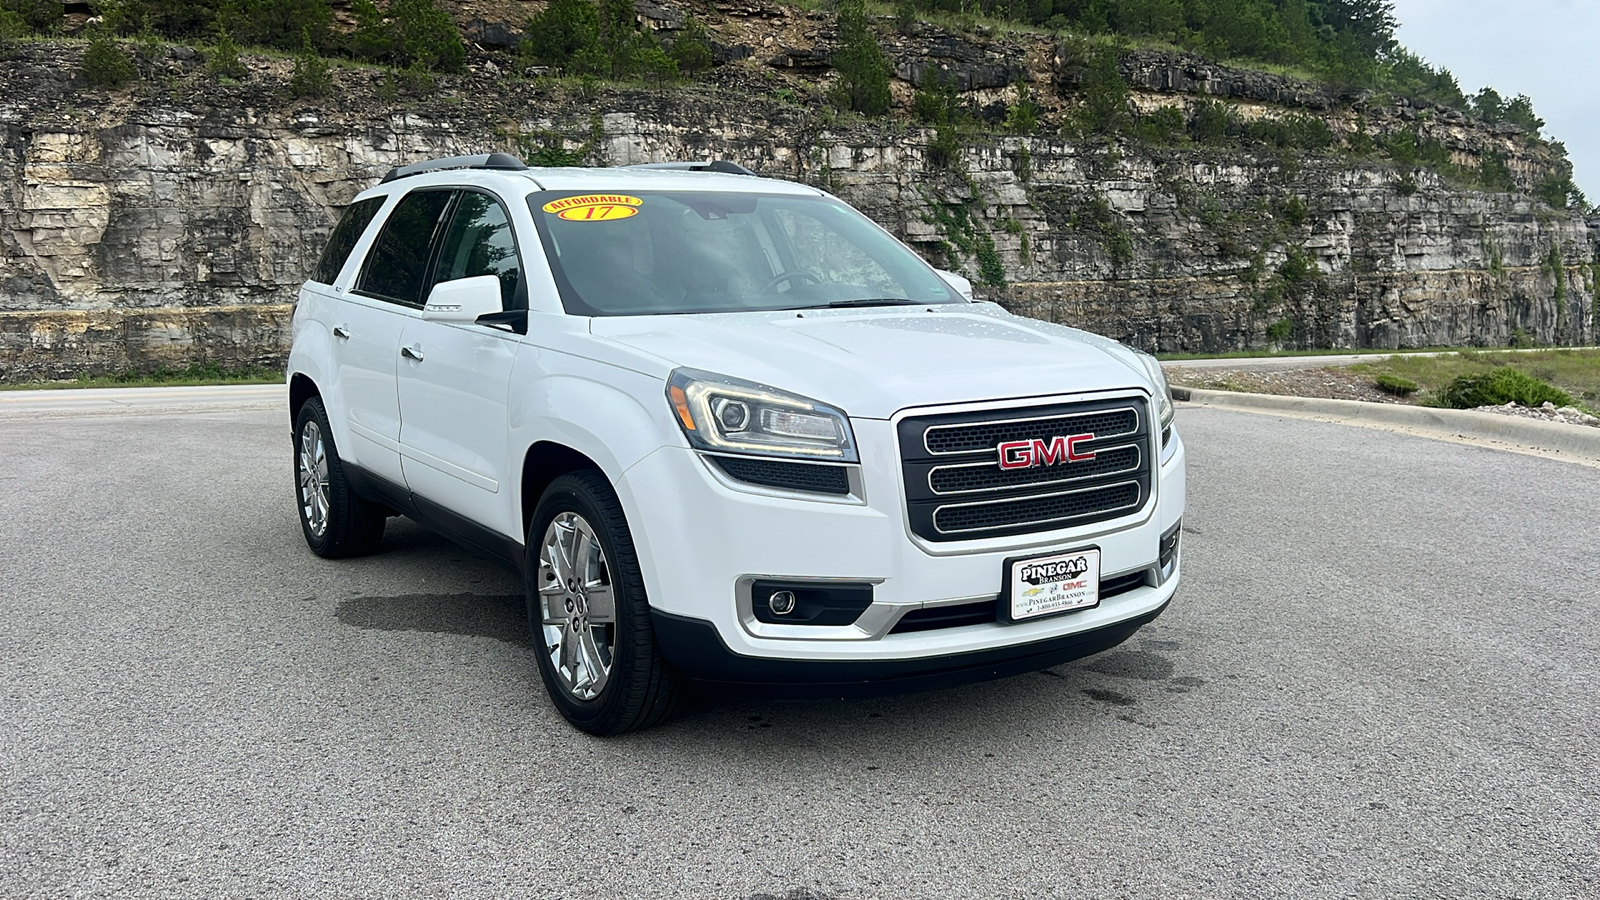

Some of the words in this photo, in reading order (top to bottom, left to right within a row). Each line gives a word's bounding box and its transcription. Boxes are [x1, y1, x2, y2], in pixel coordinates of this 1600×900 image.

[549, 196, 632, 210] AFFORDABLE
[583, 206, 614, 219] 17
[997, 433, 1096, 471] GMC
[1021, 557, 1087, 581] PINEGAR
[1040, 573, 1072, 584] BRANSON
[1062, 580, 1087, 591] GMC
